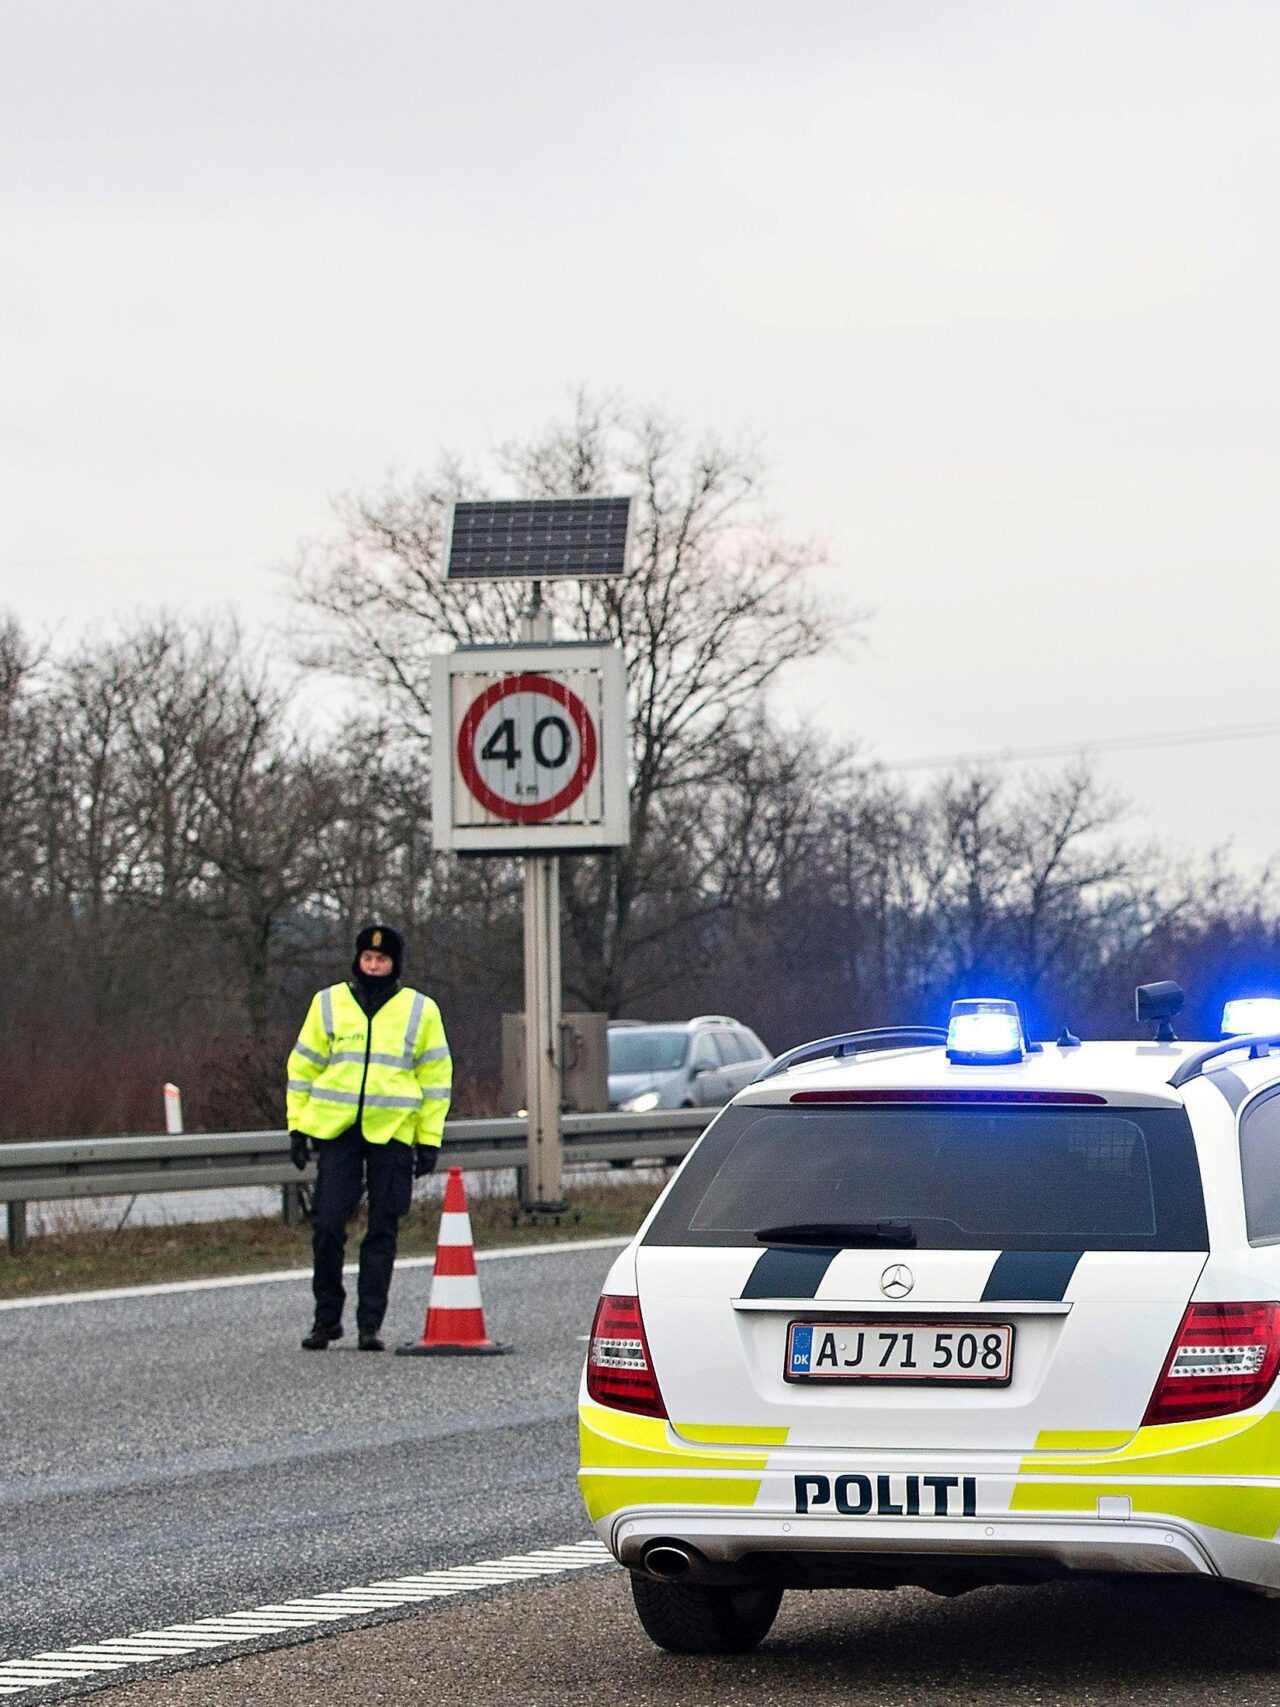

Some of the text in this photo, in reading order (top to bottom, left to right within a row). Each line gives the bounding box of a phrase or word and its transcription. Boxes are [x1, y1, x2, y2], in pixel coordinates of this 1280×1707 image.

[482, 717, 571, 769] 40
[794, 1354, 808, 1365] DK
[816, 1332, 1003, 1369] AJ 71 508
[794, 1474, 977, 1516] POLITI
